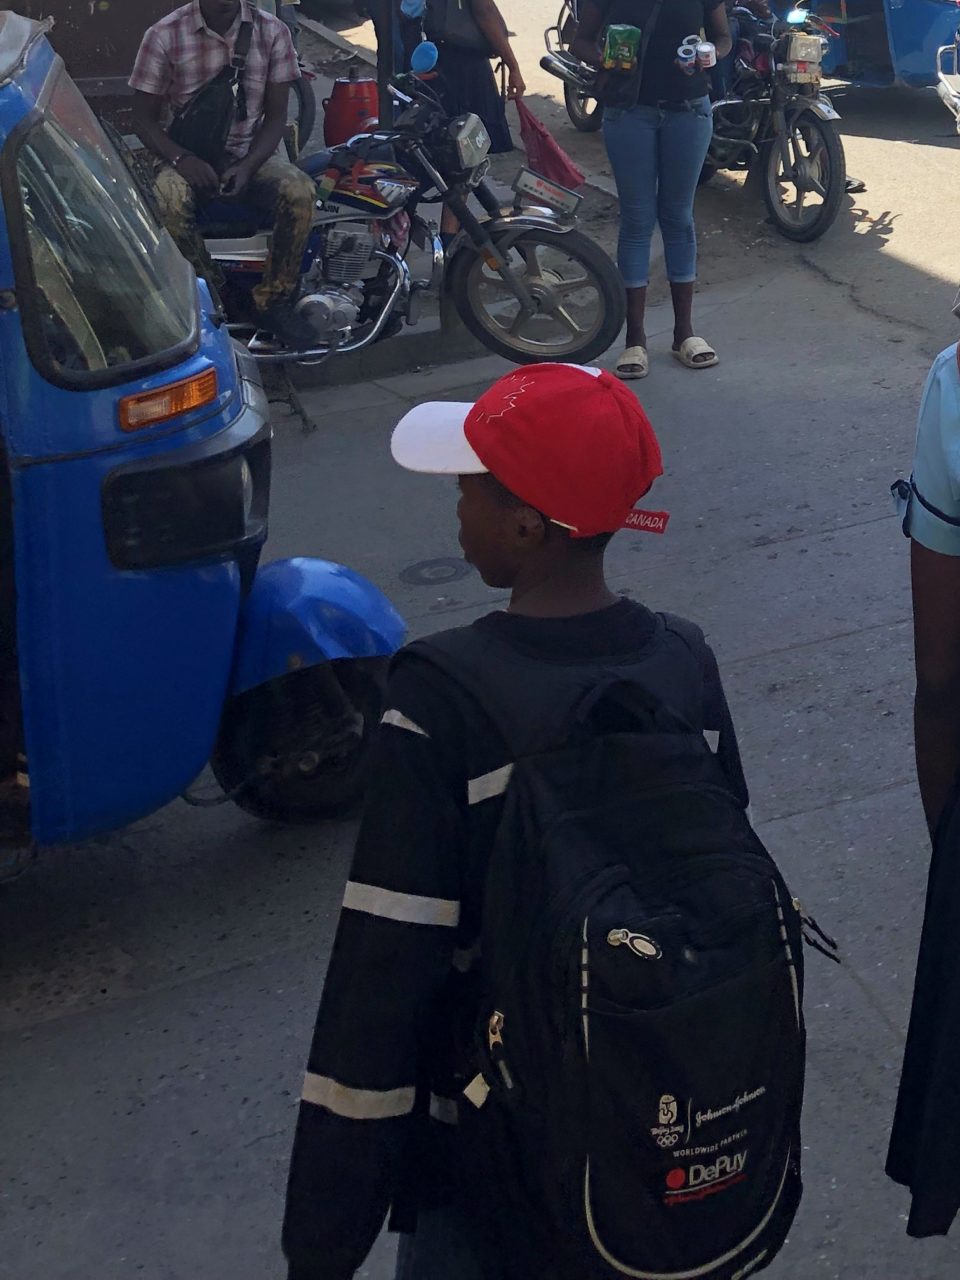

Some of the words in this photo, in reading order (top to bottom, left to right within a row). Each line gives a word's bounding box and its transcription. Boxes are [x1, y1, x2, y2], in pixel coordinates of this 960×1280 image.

[625, 512, 664, 530] CANADA
[672, 1143, 719, 1158] WORLDWIDE
[688, 1149, 748, 1186] DePuy
